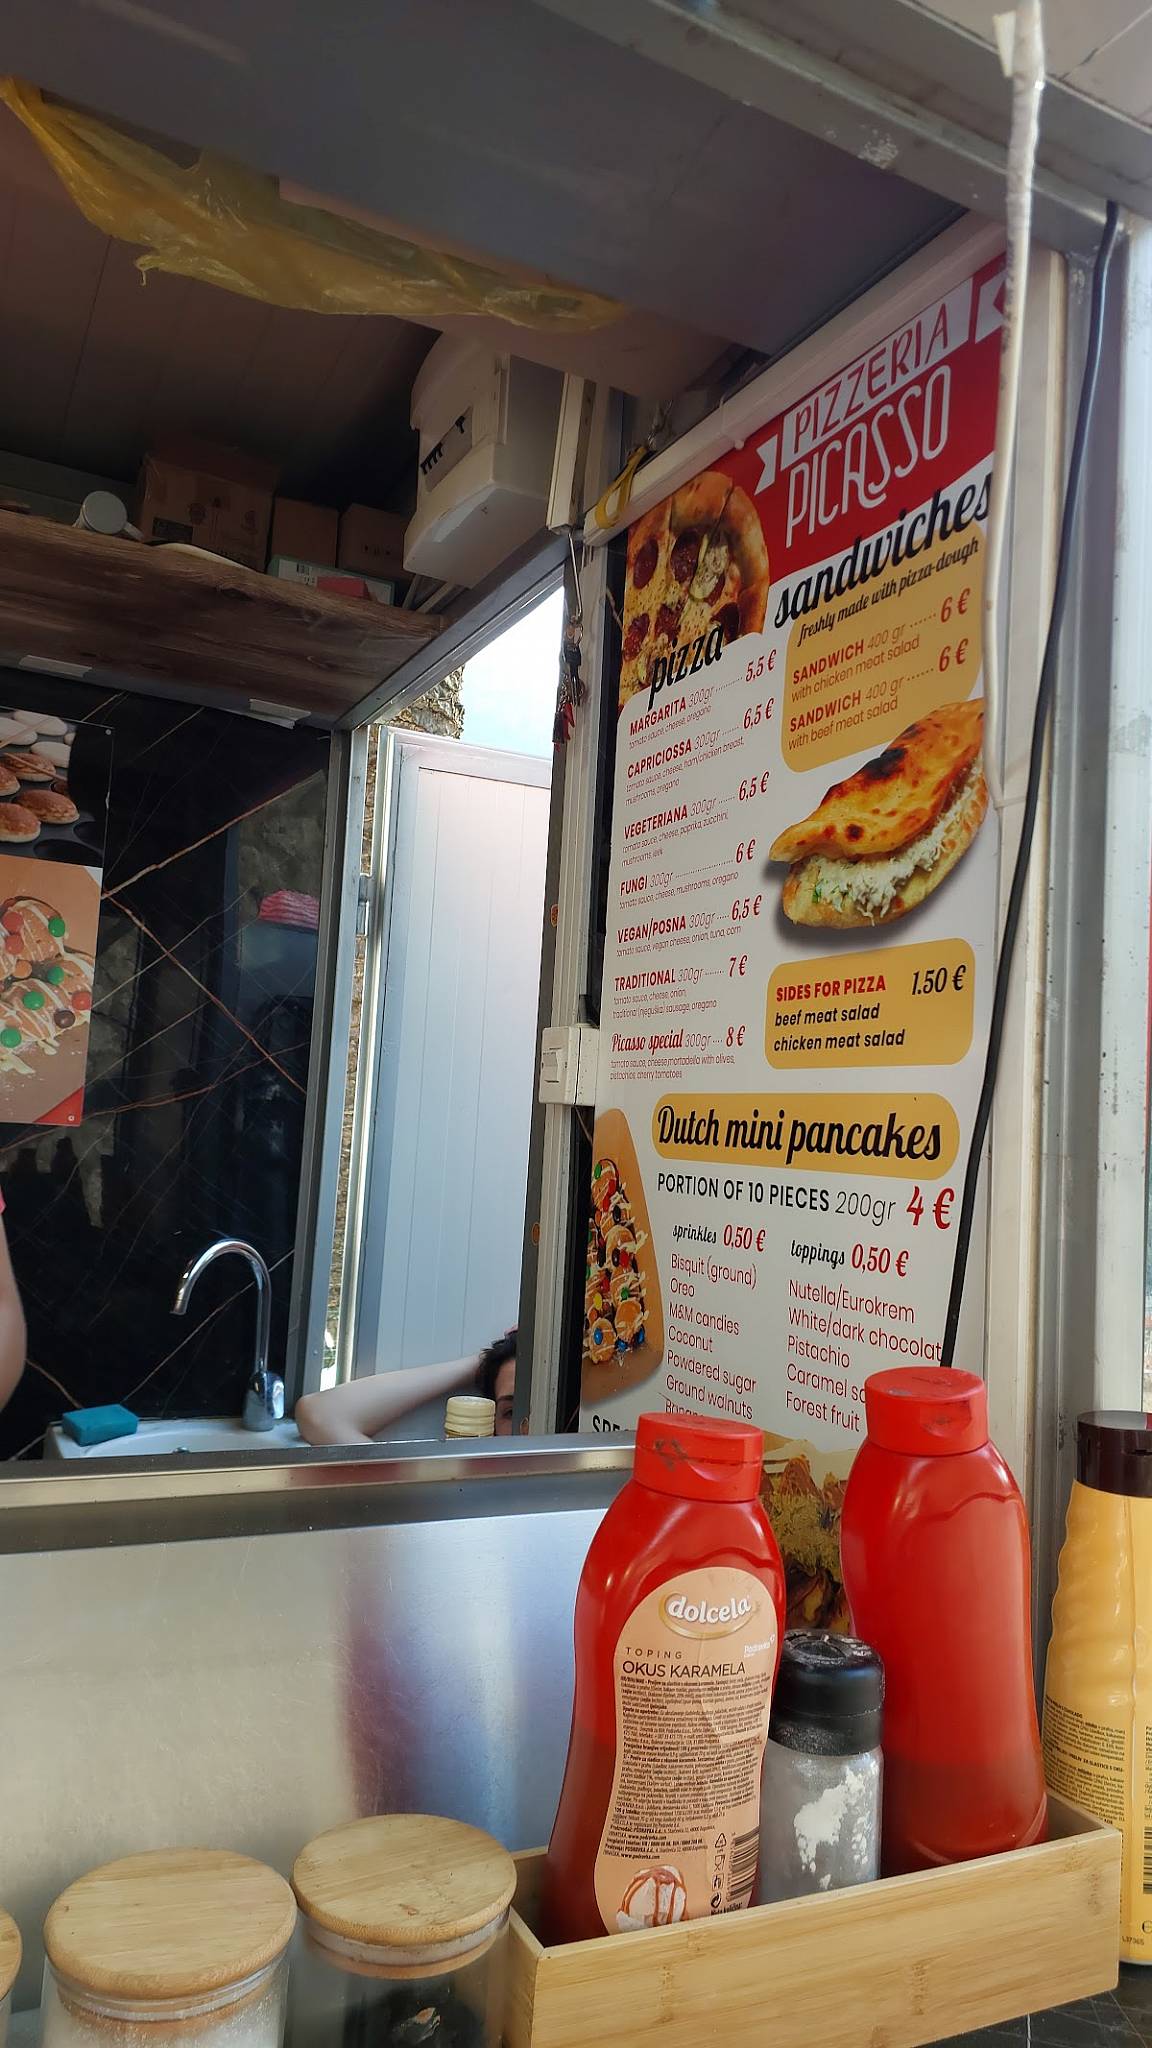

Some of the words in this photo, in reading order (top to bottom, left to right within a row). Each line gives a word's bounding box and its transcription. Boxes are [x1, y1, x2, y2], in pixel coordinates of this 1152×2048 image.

[794, 303, 948, 453] PIZZERIA
[786, 365, 951, 548] PICASSO
[774, 472, 992, 628] sandwiches
[797, 612, 835, 647] freshly
[837, 596, 869, 622] made
[871, 579, 897, 605] with
[898, 536, 979, 597] pizza-dough
[793, 639, 864, 684] SANDWICH
[867, 629, 889, 649] 400
[892, 624, 906, 644] gr
[941, 597, 952, 623] 6
[957, 588, 970, 615] €
[649, 625, 723, 711] pizza
[790, 690, 861, 732] SANDWICH
[865, 681, 887, 701] 400
[889, 676, 904, 696] gr
[939, 646, 950, 672] 6
[955, 638, 968, 665] €
[792, 685, 812, 703] with
[814, 667, 853, 693] chicken
[856, 651, 885, 674] meat
[887, 634, 919, 660] salad
[630, 697, 686, 736] MARGARITA
[688, 686, 714, 708] 300gr
[767, 649, 776, 671] €
[628, 739, 692, 779] CAPRICIOSSA
[694, 729, 720, 750] 300gr
[744, 704, 762, 729] 6,5
[765, 698, 774, 720] €
[629, 735, 647, 750] tomato
[687, 705, 712, 722] oregano
[789, 733, 809, 750] with
[811, 721, 834, 742] beef
[836, 710, 864, 732] meat
[867, 695, 898, 720] salad
[624, 805, 688, 840] VEGETERIANA
[690, 798, 716, 817] 300gr
[739, 777, 757, 801] 6,5
[760, 771, 769, 793] €
[621, 875, 647, 896] FUNGI
[650, 872, 673, 888] 300gr
[736, 842, 744, 863] 6
[747, 839, 756, 860] €
[712, 872, 739, 886] oregano
[618, 915, 686, 943] VEGAN/POSNA
[689, 912, 715, 930] 300gr
[732, 898, 750, 921] 6,5
[753, 895, 762, 916] €
[615, 969, 675, 991] TRADITIONAL
[678, 967, 704, 984] 300gr
[729, 957, 737, 977] 7
[739, 955, 747, 976] €
[776, 984, 811, 1002] SIDES
[814, 981, 840, 998] FOR
[844, 975, 886, 995] PIZZA
[912, 967, 947, 995] 1.50
[952, 965, 966, 991] €
[691, 1000, 717, 1011] oregano
[775, 1009, 802, 1027] beef
[804, 1008, 838, 1024] meat
[841, 1003, 880, 1021] salad
[612, 1034, 646, 1052] Picasso
[648, 1028, 684, 1055] special
[685, 1033, 711, 1051] 300gr
[726, 1027, 734, 1047] 8
[737, 1025, 745, 1046] €
[701, 1054, 714, 1064] with
[774, 1035, 822, 1051] chicken
[825, 1033, 861, 1049] meat
[864, 1029, 905, 1047] salad
[657, 1106, 719, 1146] Dutch
[725, 1109, 785, 1151] mini
[785, 1113, 940, 1165] pancakes
[658, 1173, 718, 1198] PORTION
[724, 1180, 743, 1200] OF
[748, 1182, 764, 1203] 10
[770, 1184, 829, 1211] PIECES
[835, 1192, 896, 1227] 200gr
[906, 1186, 924, 1226] 4
[932, 1188, 954, 1229] €
[673, 1224, 716, 1244] sprinkles
[724, 1224, 752, 1250] 0,50
[756, 1229, 766, 1252] €
[791, 1240, 845, 1270] toppings
[852, 1244, 890, 1274] 0,50
[896, 1251, 909, 1277] €
[671, 1278, 695, 1297] Oreo
[672, 1253, 704, 1277] Bisquit
[707, 1256, 756, 1290] (ground)
[670, 1302, 693, 1322] M&M
[696, 1312, 739, 1335] candies
[790, 1279, 914, 1323] Nutella/Eurokrem
[669, 1325, 713, 1353] Coconut
[788, 1335, 850, 1368] Pistachio
[789, 1307, 864, 1343] White/dark
[869, 1328, 943, 1364] chocolat
[668, 1349, 720, 1381] Powdered
[723, 1371, 756, 1395] sugar
[787, 1363, 847, 1398] Caramel
[667, 1374, 705, 1402] Ground
[708, 1392, 752, 1420] walnuts
[787, 1391, 827, 1421] Forest
[831, 1405, 859, 1432] fruit
[668, 1596, 751, 1624] dolcela
[622, 1660, 666, 1677] OKUS
[670, 1661, 746, 1678] KARAMELA
[625, 1646, 682, 1660] TOPING
